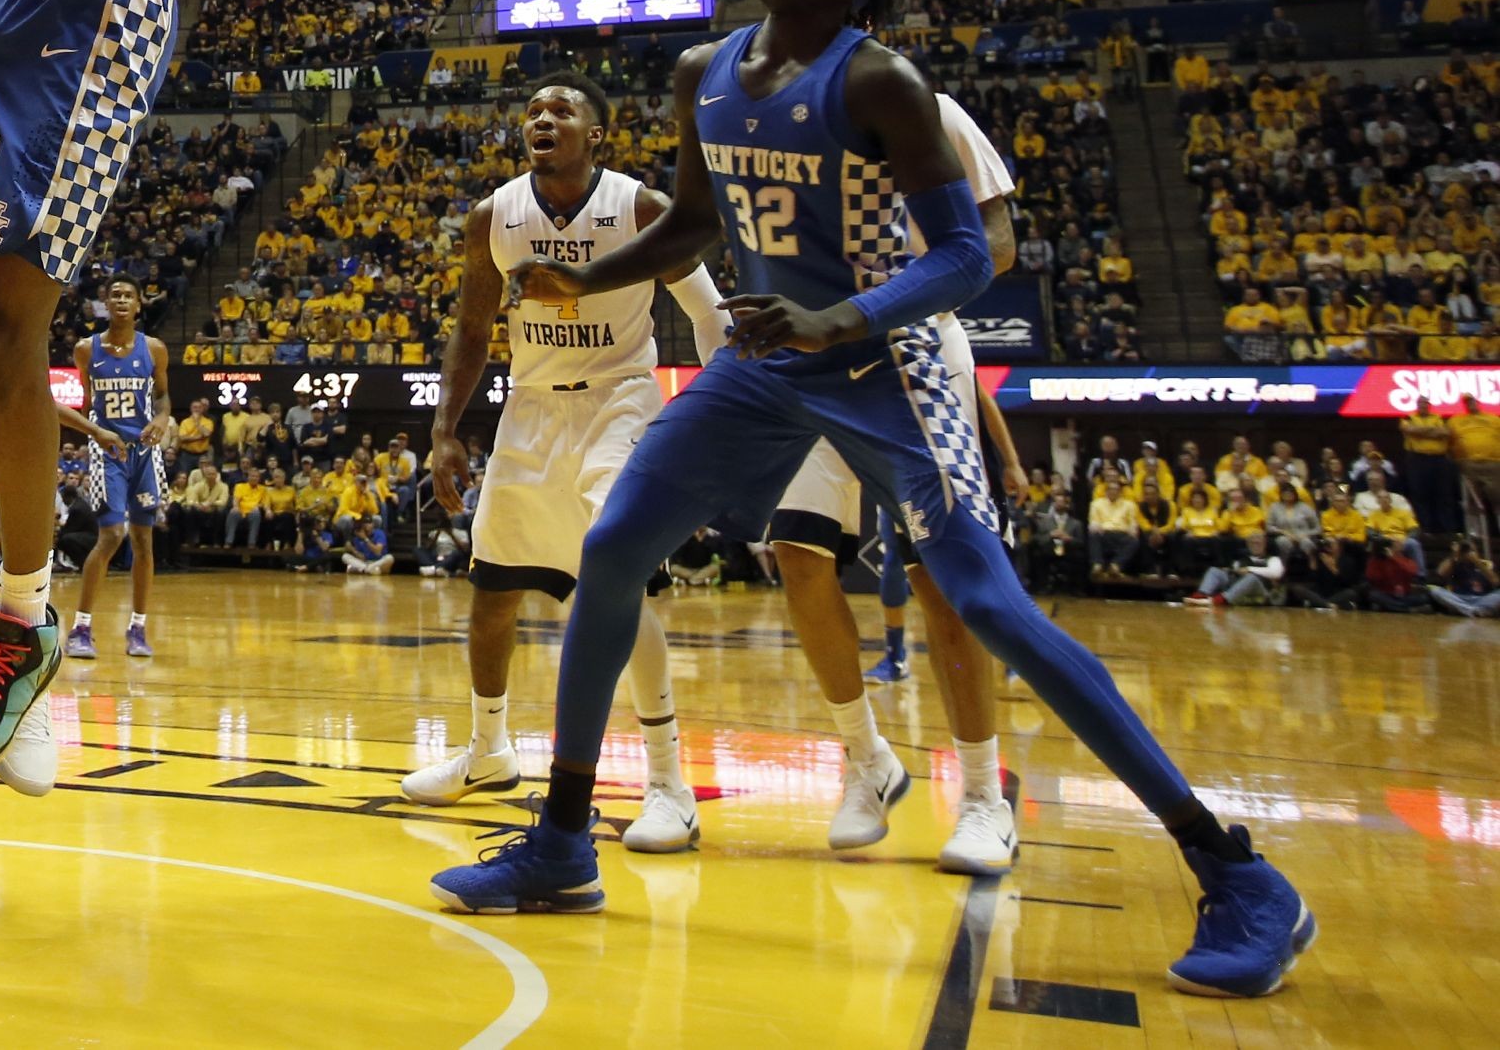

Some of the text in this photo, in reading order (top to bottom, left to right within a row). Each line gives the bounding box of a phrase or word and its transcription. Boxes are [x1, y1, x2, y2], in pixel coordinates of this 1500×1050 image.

[726, 182, 800, 257] 32
[530, 240, 595, 263] WEST
[523, 321, 615, 348] VIRGINIA
[293, 372, 360, 397] 4:37
[410, 382, 440, 406] 20
[1388, 369, 1500, 412] SHONE
[105, 392, 136, 419] 22
